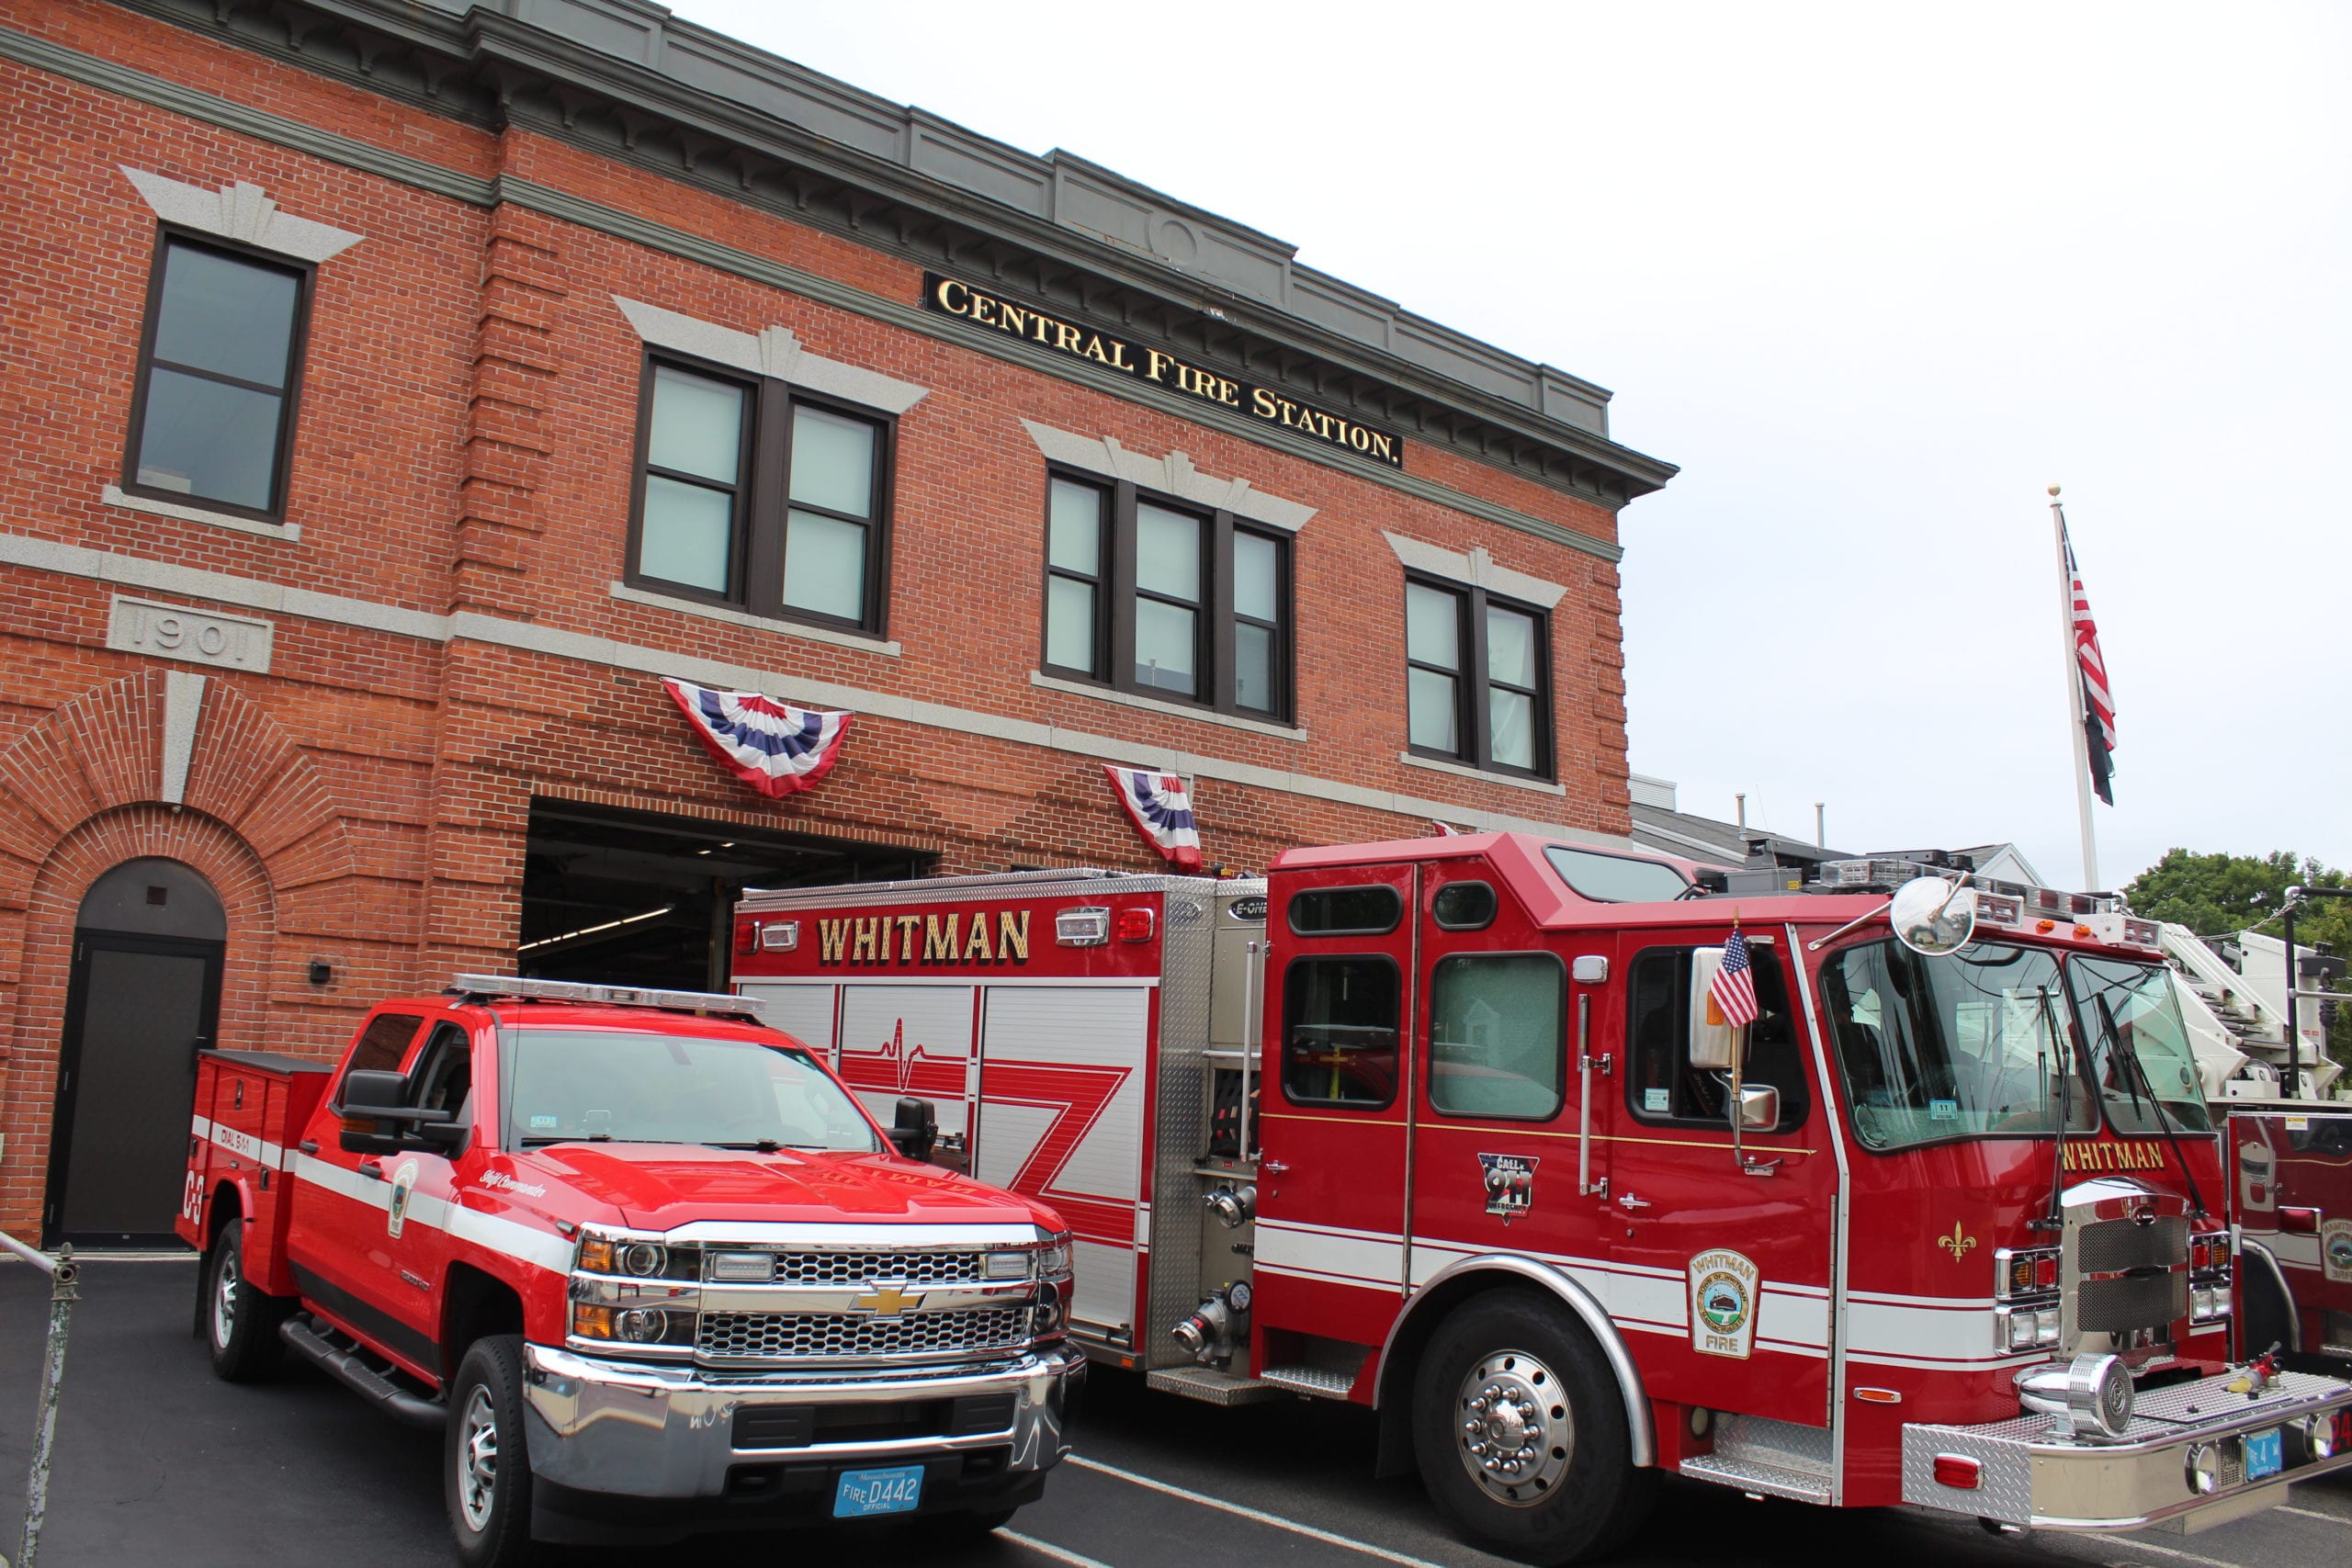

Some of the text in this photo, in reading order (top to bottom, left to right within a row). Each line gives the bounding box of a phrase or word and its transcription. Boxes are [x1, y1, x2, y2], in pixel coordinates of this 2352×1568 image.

[937, 279, 1399, 464] CENTRAL FIRE STATION.
[131, 610, 249, 661] 1901
[819, 910, 1030, 964] WHITMAN
[221, 1129, 234, 1146] DIAL
[1497, 1156, 1520, 1169] CALL
[184, 1170, 204, 1225] C-3
[1487, 1168, 1530, 1205] 911
[1692, 1254, 1755, 1280] WHITMAN
[1705, 1335, 1737, 1352] FIRE
[842, 1484, 866, 1504] FIRE
[863, 1503, 890, 1511] OFFICIAL
